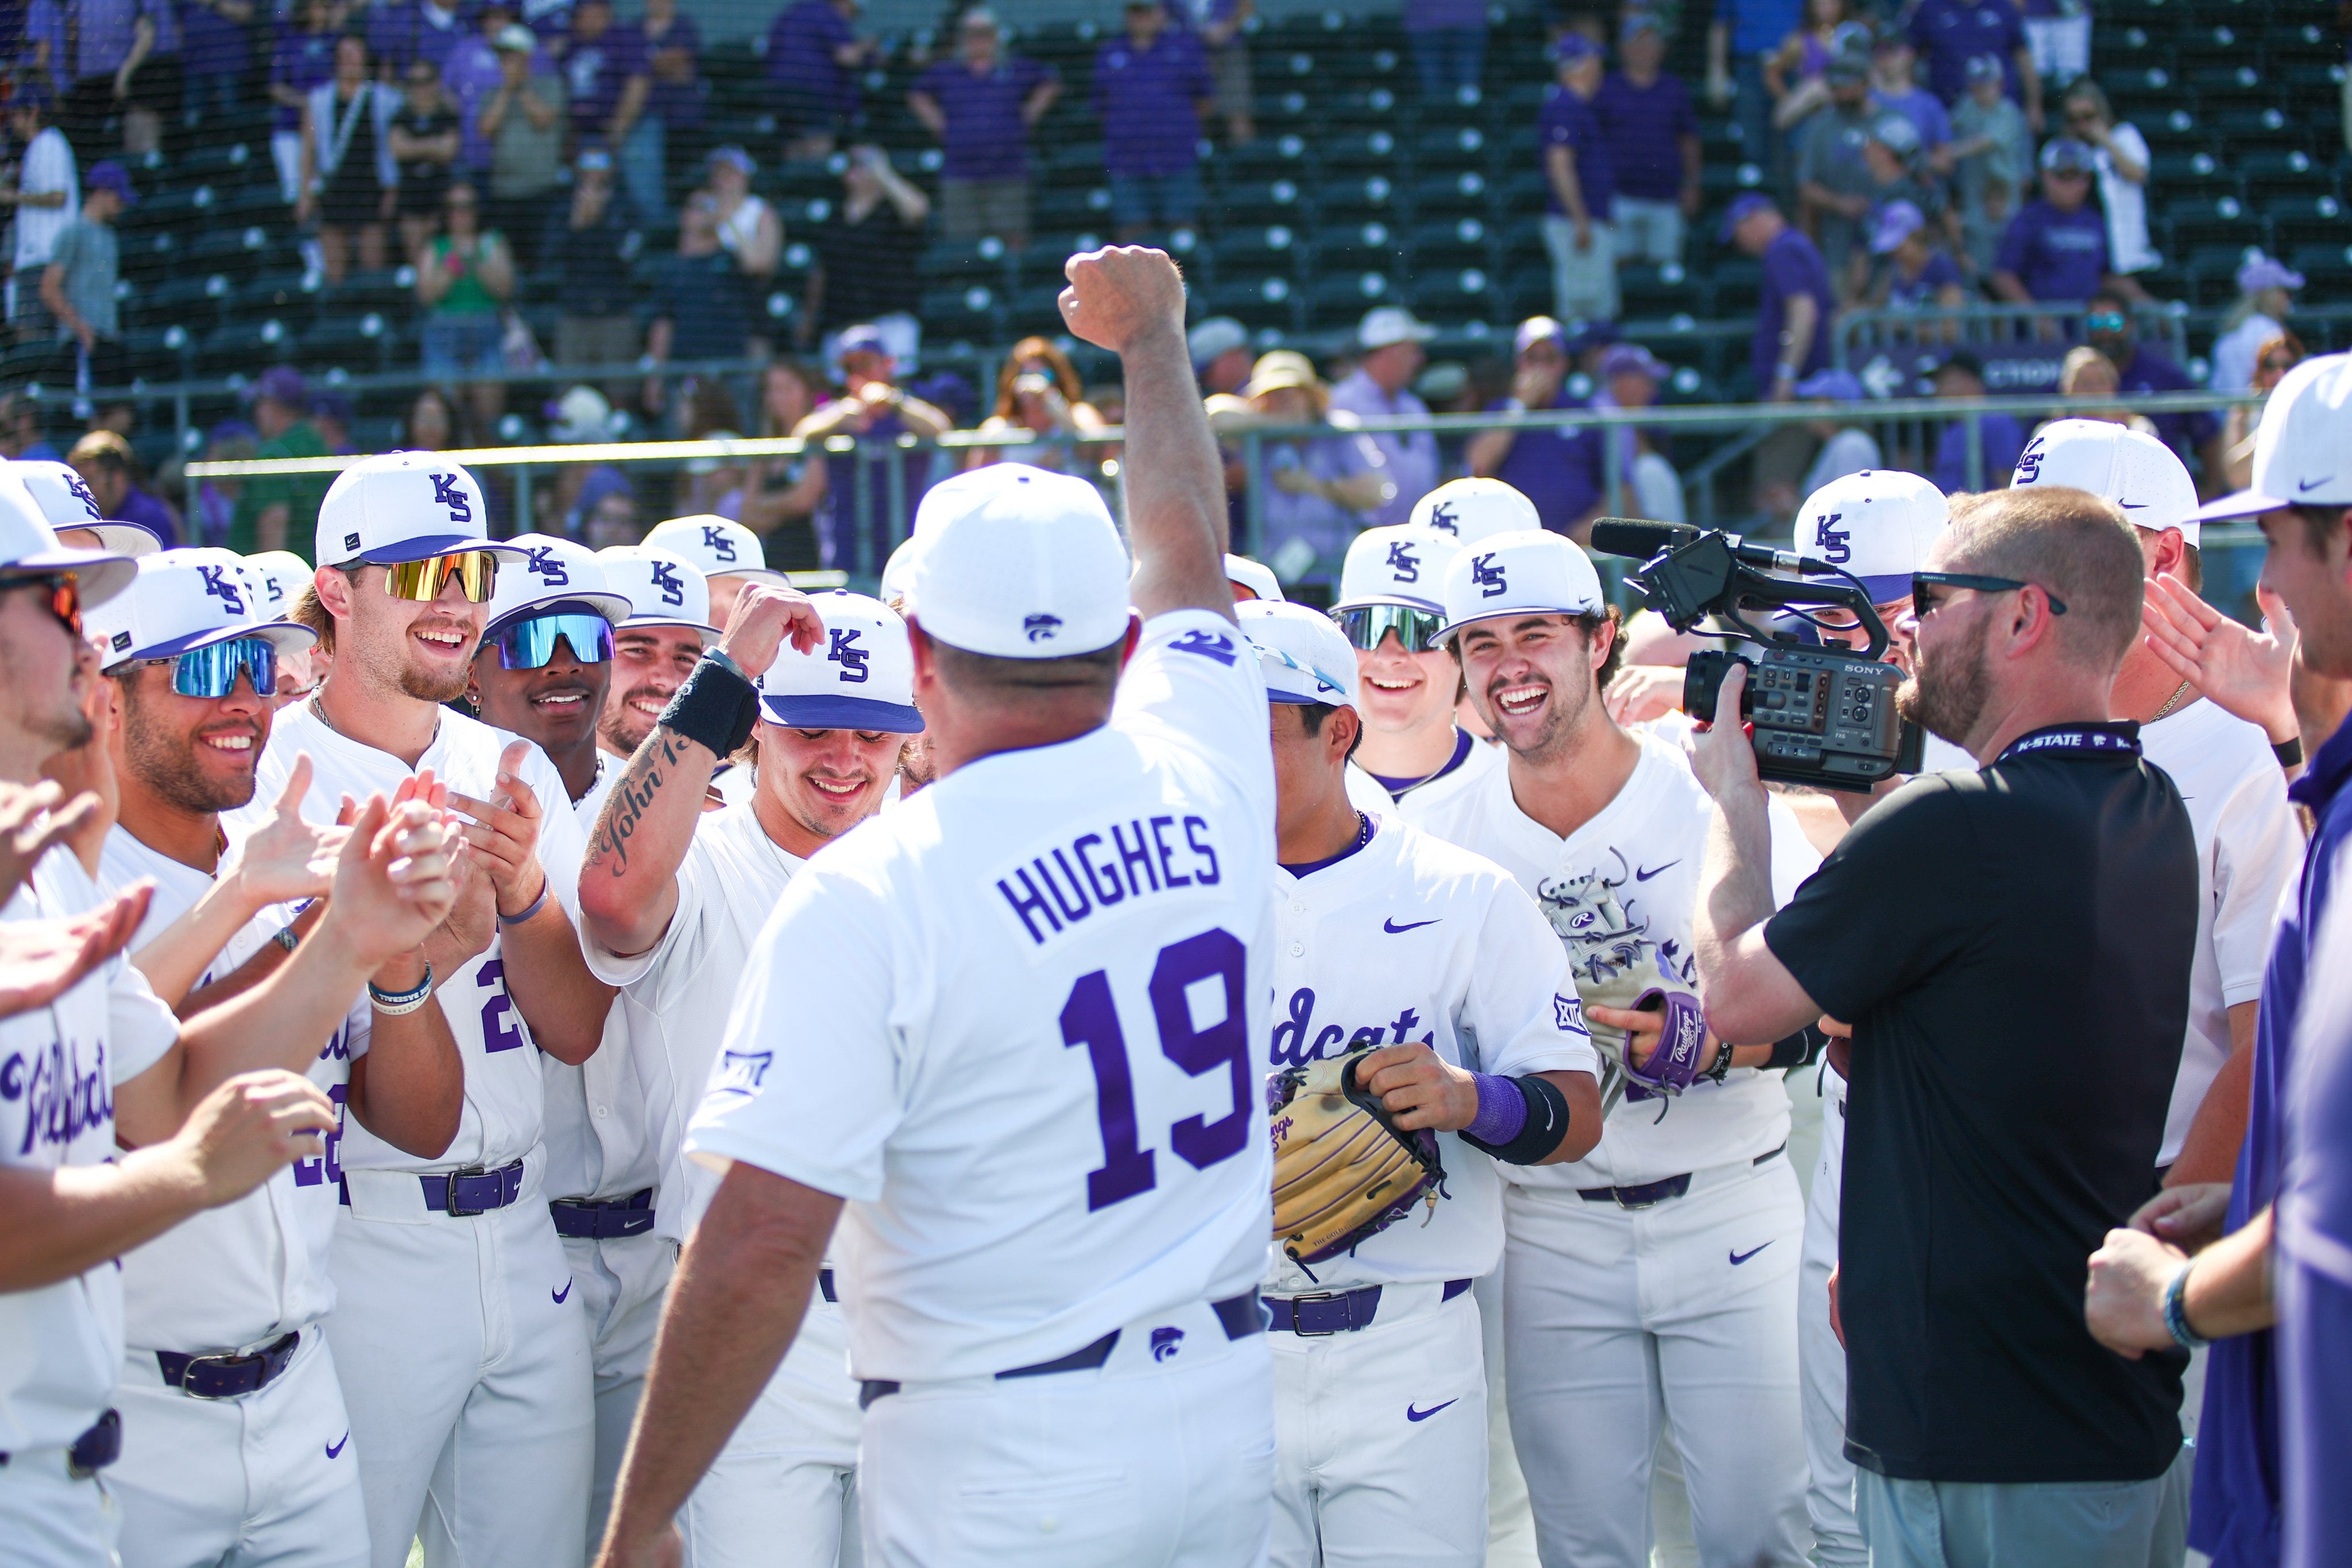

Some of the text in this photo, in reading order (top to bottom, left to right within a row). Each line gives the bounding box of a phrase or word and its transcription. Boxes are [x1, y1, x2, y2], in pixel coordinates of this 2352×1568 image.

[429, 474, 471, 522] KS
[702, 526, 737, 562] KS
[1386, 542, 1419, 583] KS
[1816, 514, 1850, 563] KS
[196, 564, 245, 615] KS
[528, 546, 569, 587] KS
[651, 560, 683, 606] KS
[1472, 552, 1507, 599] KS
[828, 629, 869, 683] KS
[1844, 664, 1884, 676] SONY
[2018, 734, 2083, 752] K-STATE
[601, 768, 664, 877] John
[997, 816, 1220, 944] HUGHES
[1675, 1011, 1695, 1062] Rawlings
[1058, 927, 1255, 1214] 19
